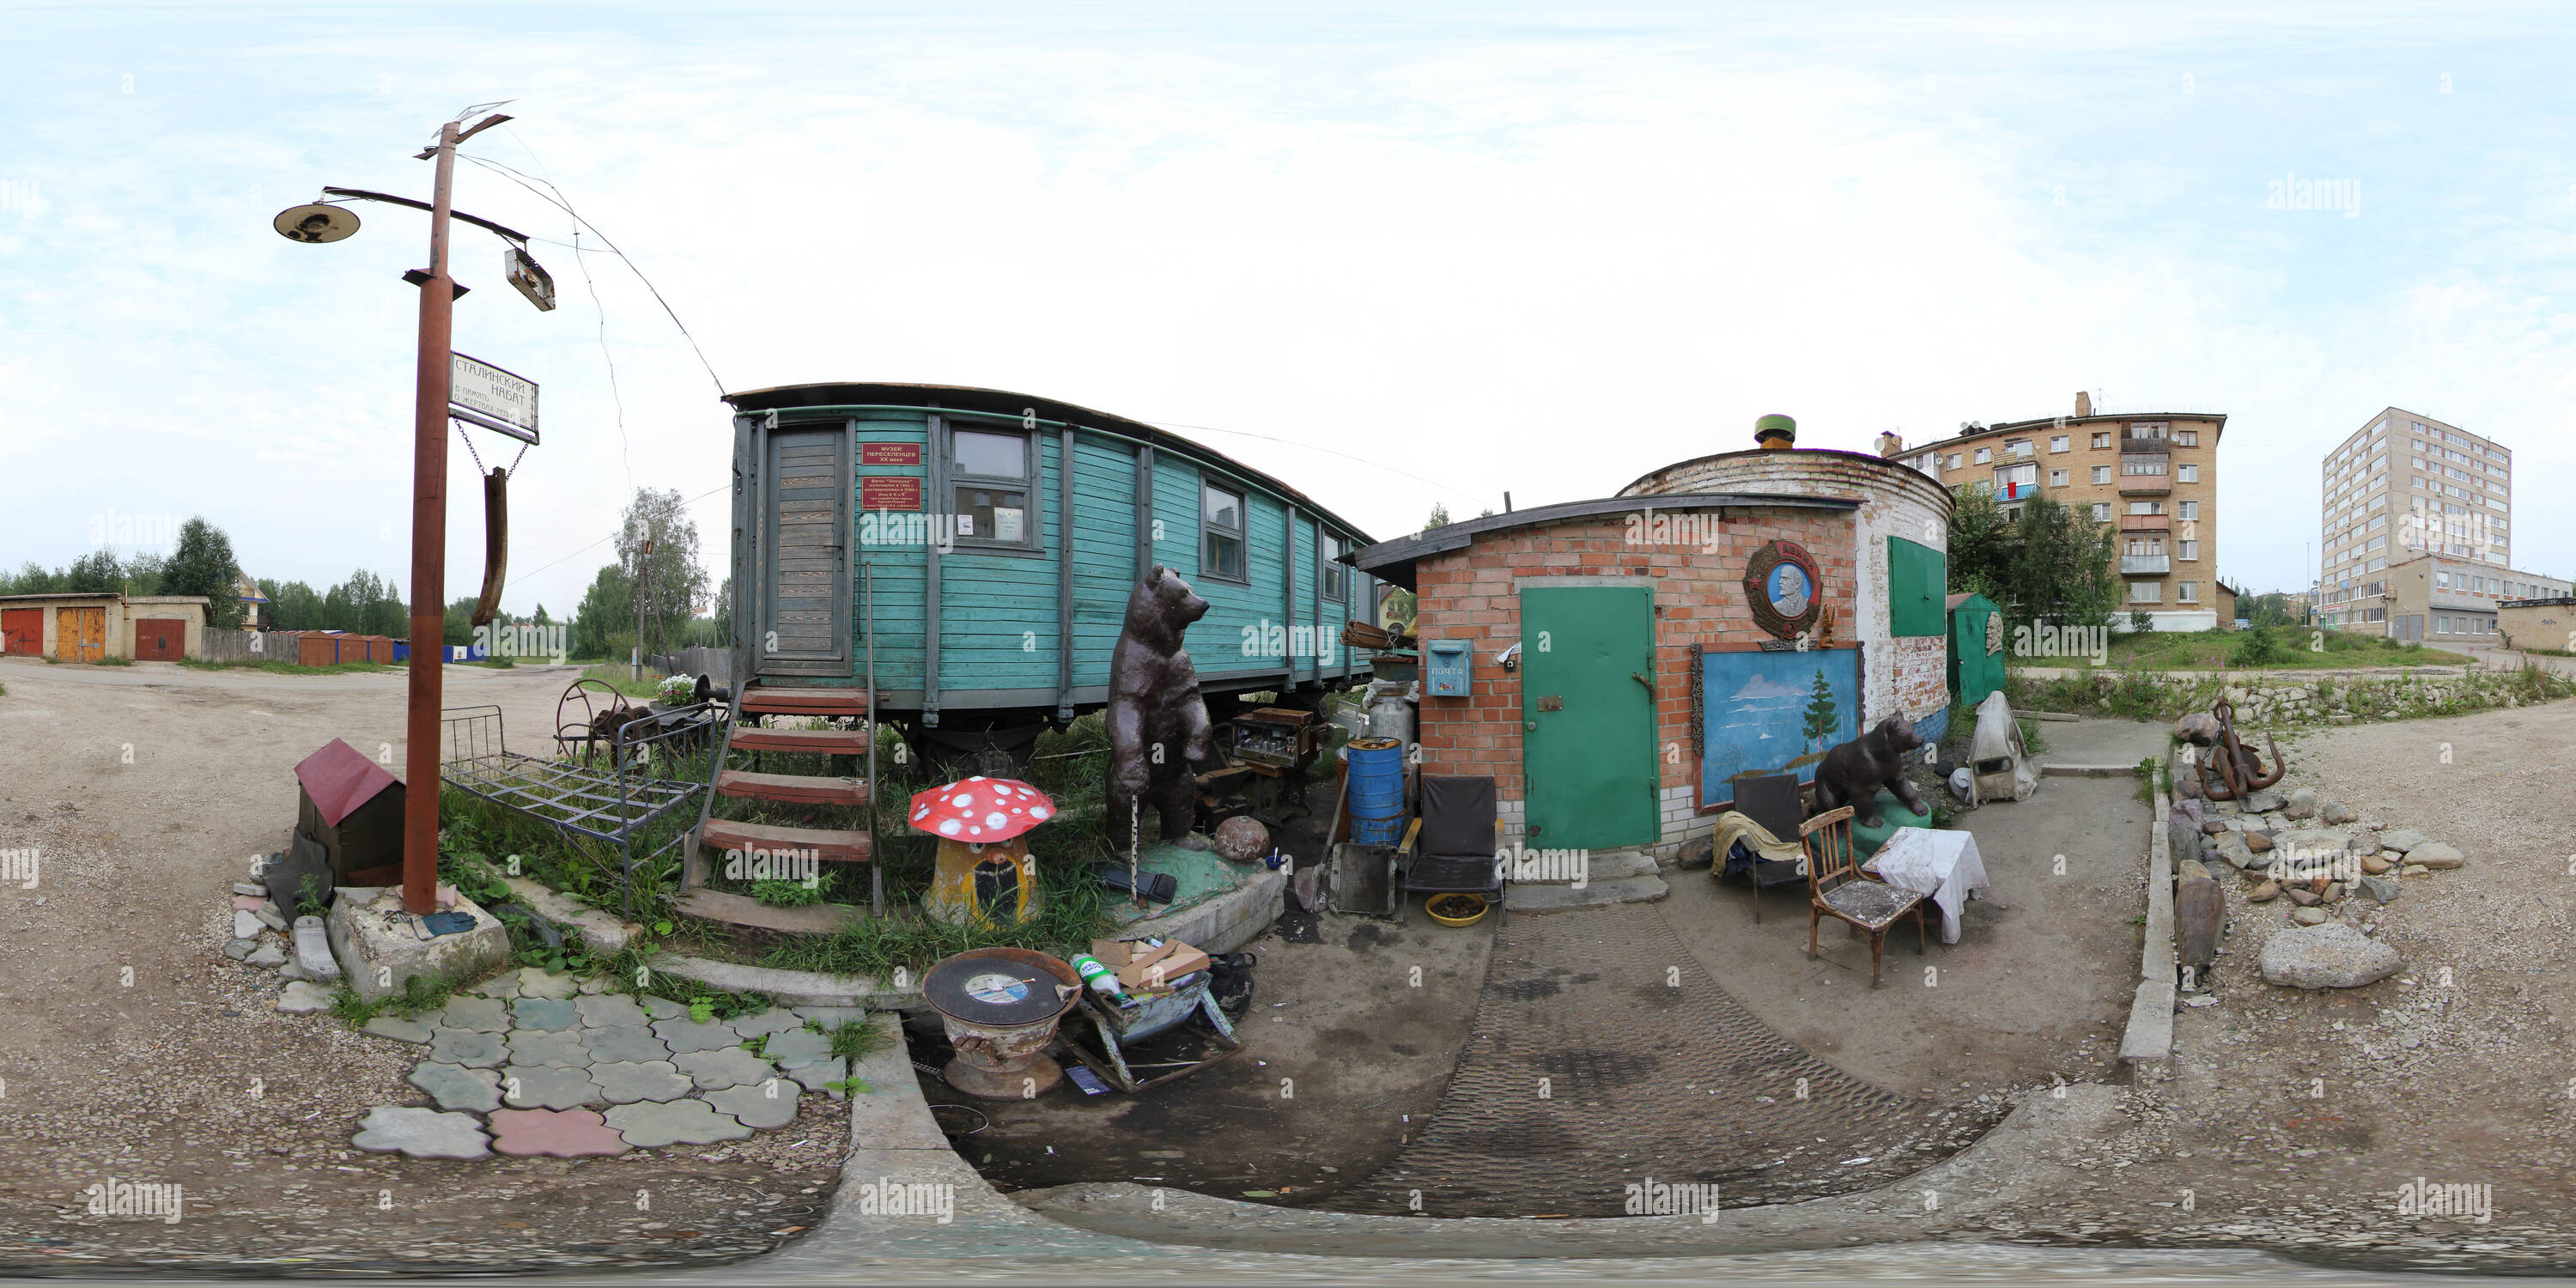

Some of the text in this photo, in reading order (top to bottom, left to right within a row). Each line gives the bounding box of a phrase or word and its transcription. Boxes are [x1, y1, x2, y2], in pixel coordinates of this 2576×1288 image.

[455, 359, 525, 393] СТАЛИНСКИЙ
[463, 386, 489, 401] ПАМЯТЬ
[491, 384, 525, 405] НАБАТ
[463, 398, 494, 412] ЖЕРТВАХ
[1431, 667, 1463, 676] ПОЧТА
